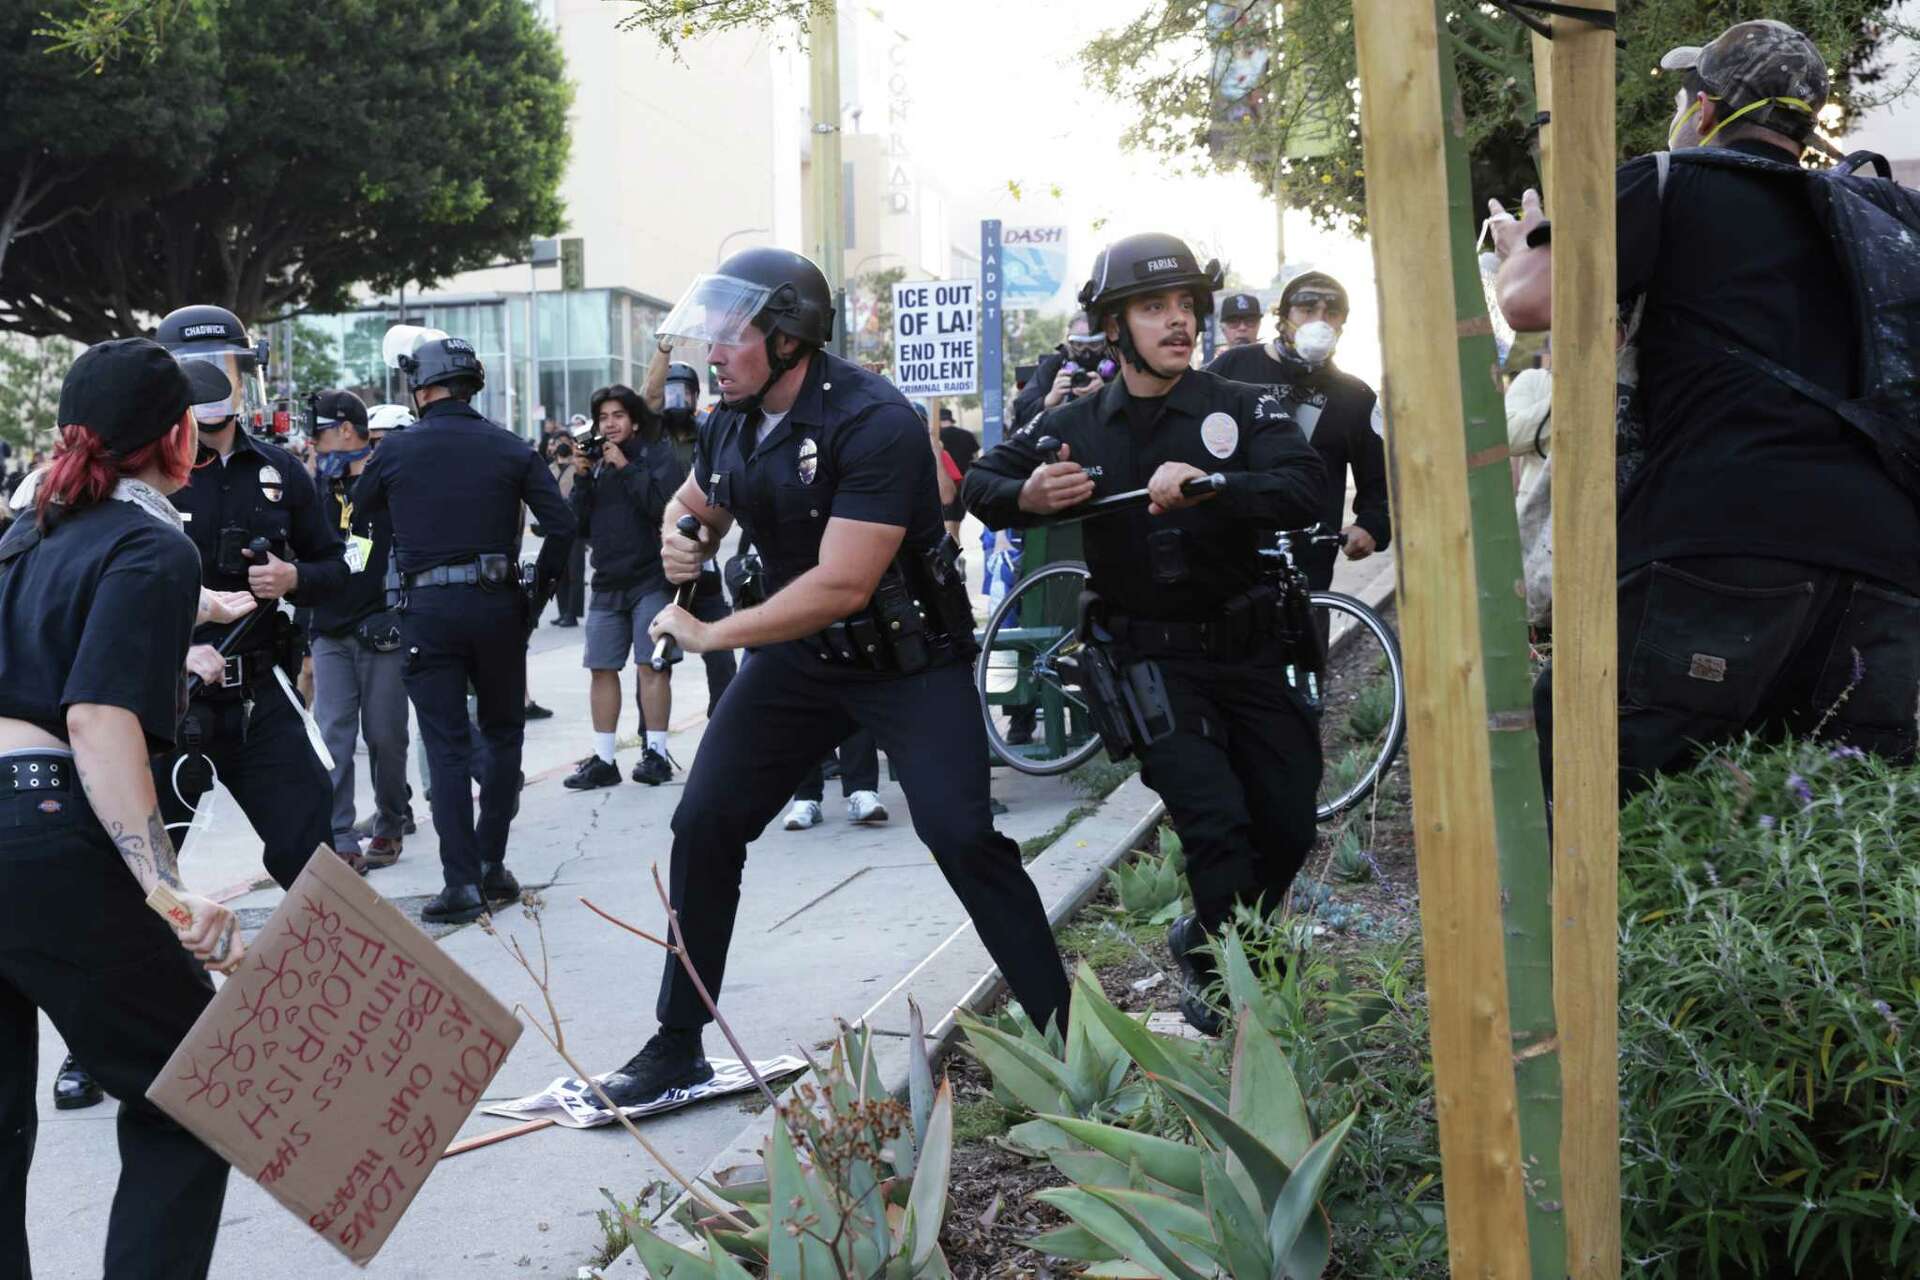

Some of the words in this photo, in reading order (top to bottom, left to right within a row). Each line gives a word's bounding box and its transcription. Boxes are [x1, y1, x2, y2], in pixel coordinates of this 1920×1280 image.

[1004, 227, 1063, 244] DASH
[985, 236, 997, 319] LADOT
[1147, 256, 1178, 273] FARIAS
[898, 288, 928, 308] ICE
[935, 286, 973, 305] OUT
[184, 324, 226, 337] CHADWICK
[899, 313, 928, 336] OF
[937, 310, 973, 334] LA!
[900, 343, 934, 362] END
[940, 340, 973, 359] THE
[900, 361, 974, 382] VIOLENT
[899, 383, 941, 394] CRIMINAL
[943, 381, 974, 392] RAIDS!
[238, 927, 386, 1140] FLOURISH
[439, 1001, 473, 1043] AS
[444, 1029, 508, 1109] FOR
[380, 1063, 433, 1138] OUR
[256, 1121, 311, 1184] SHALL
[399, 1118, 437, 1169] AS
[309, 1147, 384, 1232] HEARTS
[340, 1164, 405, 1248] LONG
